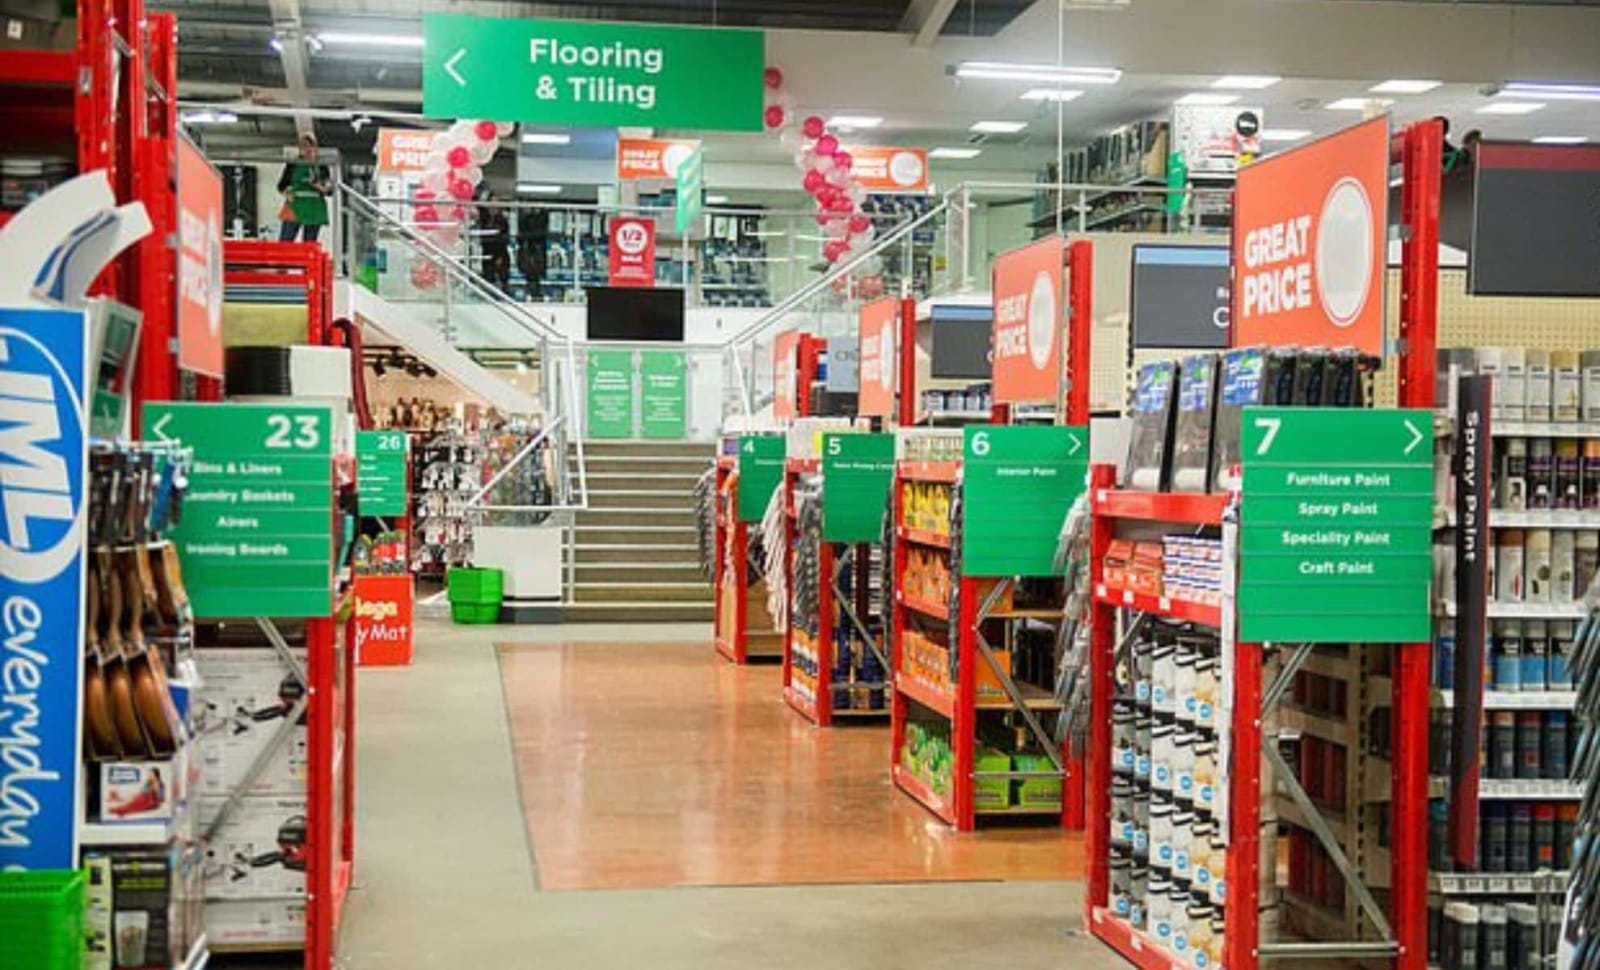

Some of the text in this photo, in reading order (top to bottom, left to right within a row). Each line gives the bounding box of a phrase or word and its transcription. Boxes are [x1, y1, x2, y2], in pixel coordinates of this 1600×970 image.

[530, 38, 664, 74] Flooring
[535, 75, 656, 109] & Tiling
[1243, 214, 1311, 269] GREAT
[1243, 262, 1312, 318] PRICE
[265, 414, 320, 448] 23
[1254, 418, 1282, 455] 7
[378, 435, 400, 450] 26
[743, 440, 754, 454] 4
[829, 438, 841, 455] 5
[971, 431, 991, 456] 6
[239, 463, 282, 474] Liners
[1286, 472, 1391, 487] Furniture Paint
[1463, 411, 1480, 562] Spray Paint
[241, 489, 295, 503] Baskets
[1298, 502, 1378, 517] Spray Paint
[1282, 531, 1390, 547] Speciality Paint
[239, 544, 288, 555] Boards
[1299, 561, 1375, 574] Craft Paint
